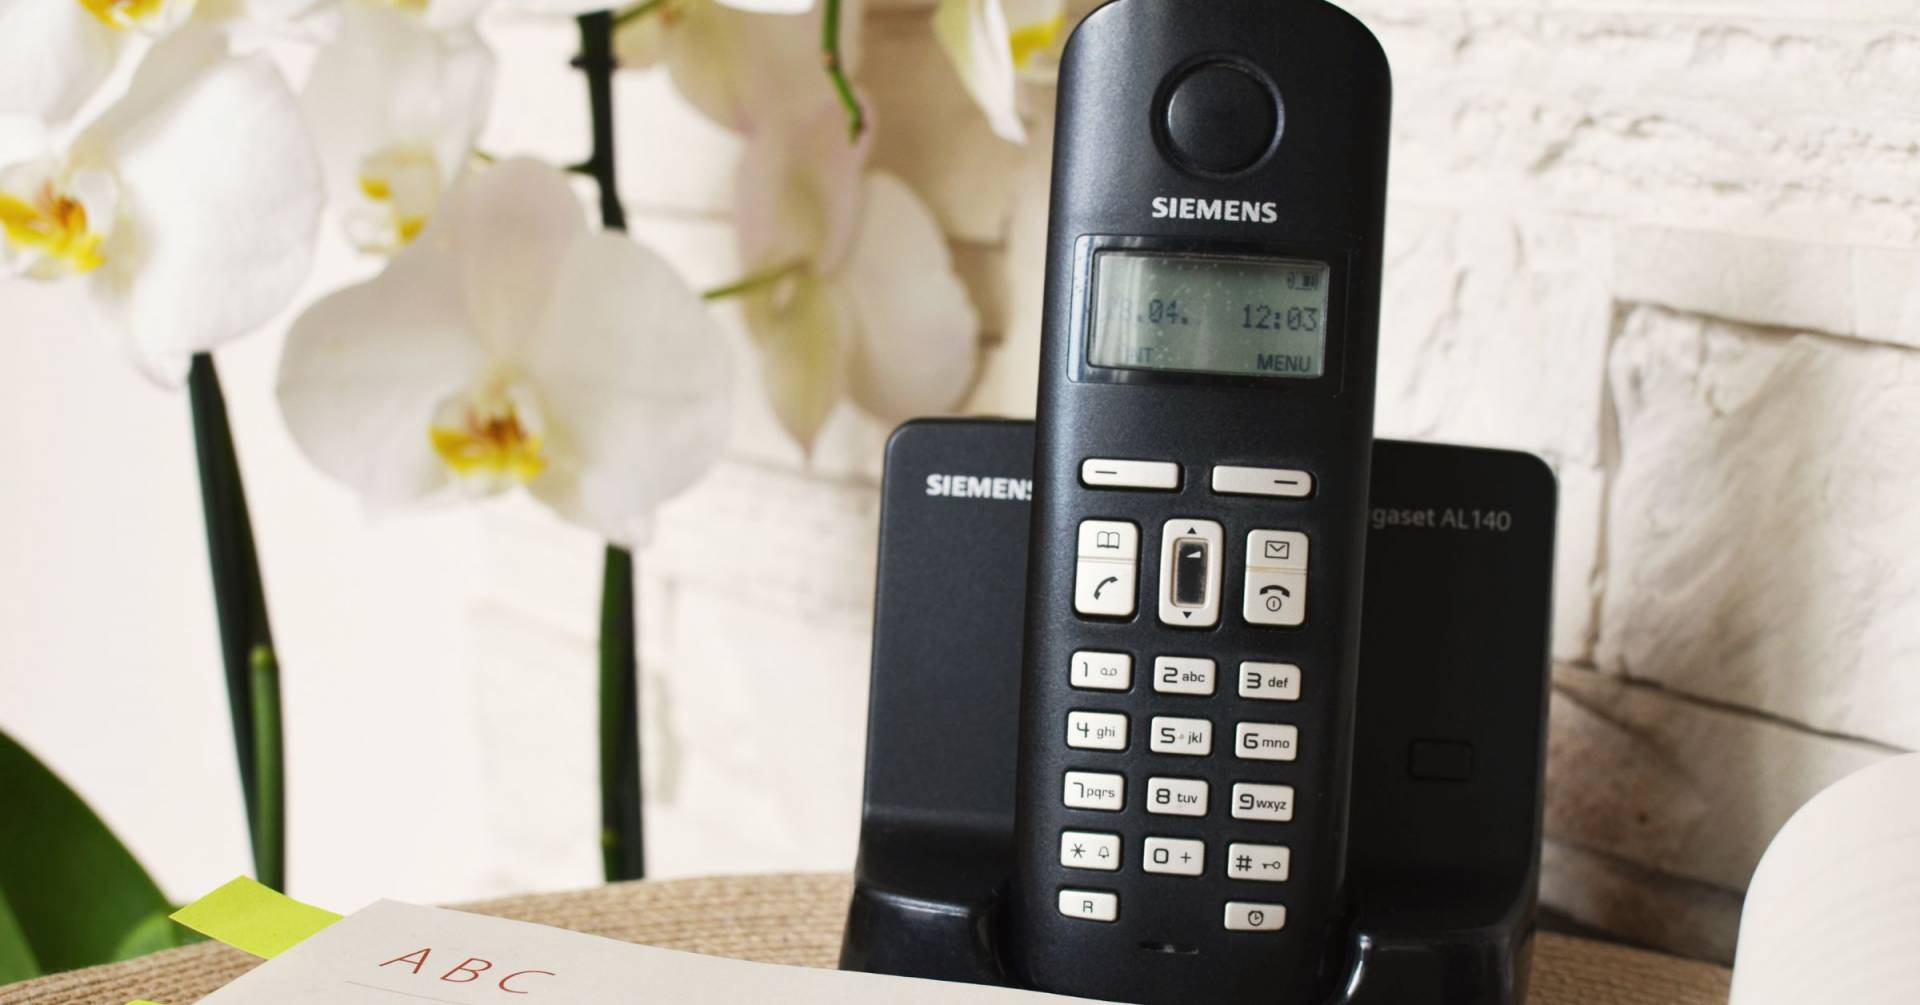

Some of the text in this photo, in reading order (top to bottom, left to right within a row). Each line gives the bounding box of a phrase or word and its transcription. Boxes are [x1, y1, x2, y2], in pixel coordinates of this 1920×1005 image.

[1151, 196, 1278, 224] SIEMENS
[1242, 303, 1318, 331] 12:03
[1256, 353, 1312, 373] MENU
[1440, 507, 1513, 532] AL140
[1162, 666, 1206, 684] 2 abc
[1246, 672, 1289, 689] 3 def
[1076, 722, 1116, 740] 4 ghi
[1160, 726, 1203, 745] 5 jkl
[1243, 732, 1291, 750] 6 mno
[1155, 787, 1198, 805] 8 tuv
[1082, 899, 1094, 914] R
